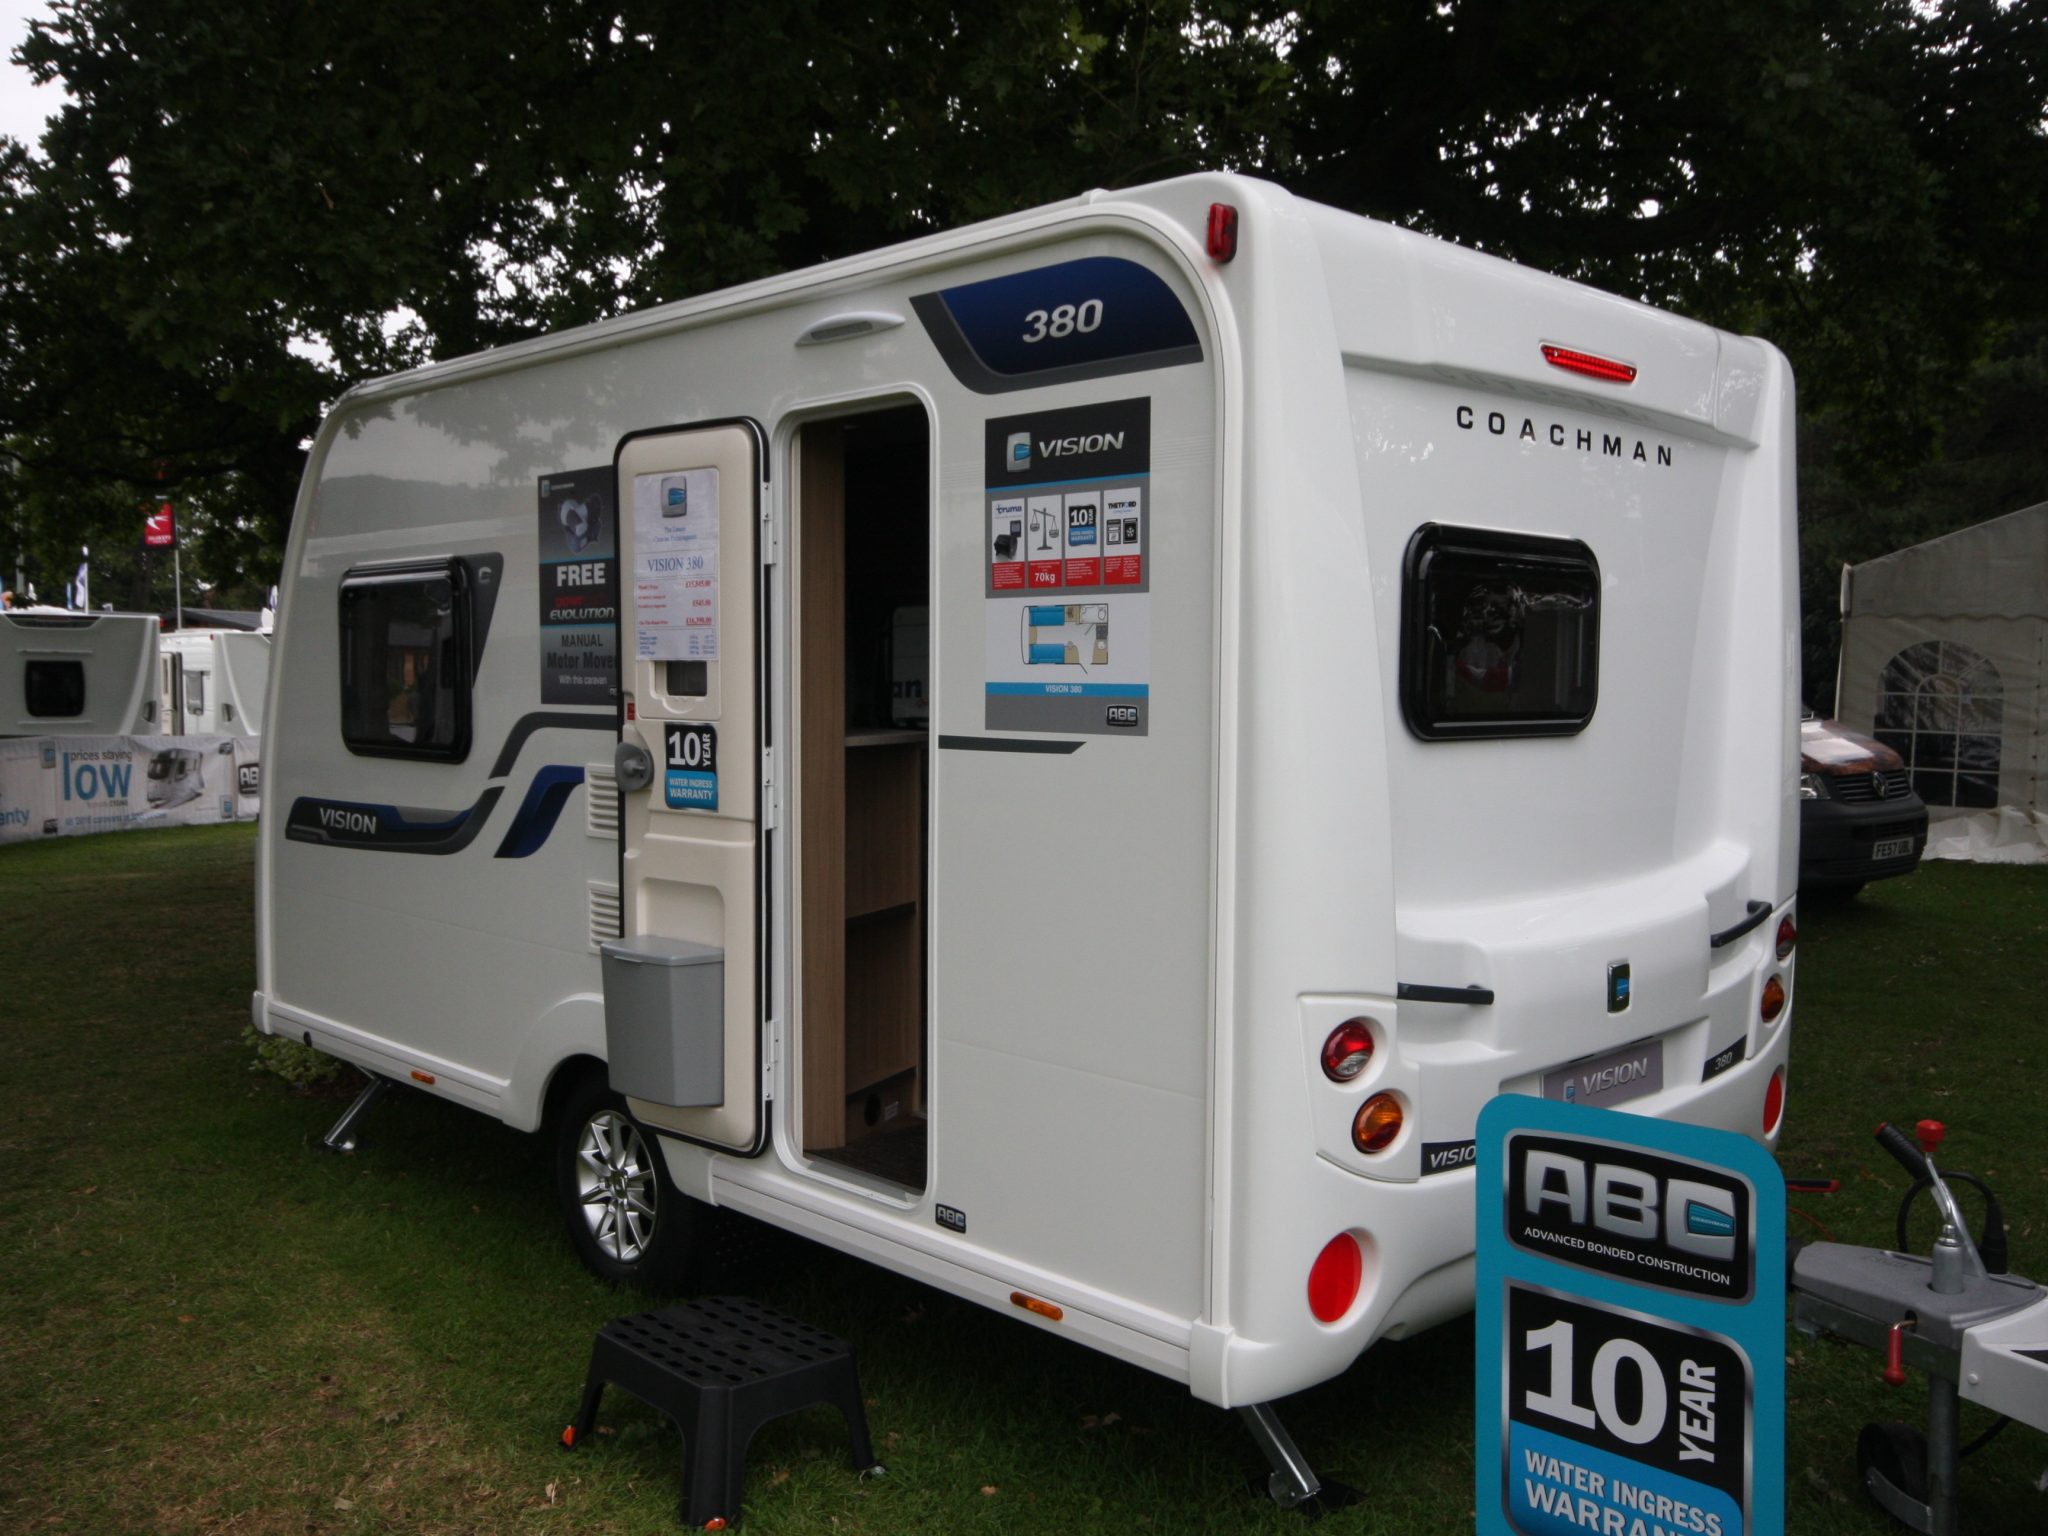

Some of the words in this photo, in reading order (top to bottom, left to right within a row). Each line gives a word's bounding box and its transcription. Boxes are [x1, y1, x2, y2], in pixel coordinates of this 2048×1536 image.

[1022, 298, 1104, 343] 380
[1039, 431, 1125, 459] VISION
[1455, 405, 1672, 467] COACHMAN
[996, 503, 1022, 514] truma
[1107, 500, 1137, 510] THETFORD
[1070, 508, 1088, 526] 10
[648, 557, 684, 572] VISION
[686, 555, 704, 570] 380
[556, 562, 606, 588] FREE
[1034, 571, 1056, 584] 70kg
[550, 606, 615, 621] EVOLUTION
[561, 633, 604, 648] MANUAL
[547, 652, 580, 669] Motor
[572, 675, 583, 685] this
[1045, 684, 1069, 693] VISION
[71, 751, 100, 762] prices
[102, 750, 132, 762] staying
[668, 731, 701, 767] 10
[702, 733, 711, 768] YEAR
[63, 752, 132, 801] low
[669, 777, 688, 787] WATER
[689, 778, 713, 789] INGRESS
[670, 788, 713, 800] WARRANTY
[319, 807, 377, 834] VISION
[1714, 1051, 1733, 1071] 380
[1582, 1057, 1648, 1096] VISION
[1430, 1145, 1476, 1169] VISIO
[1524, 1149, 1736, 1261] ABC
[937, 1206, 965, 1227] ABC
[1524, 1226, 1586, 1249] ADVANCED
[1587, 1241, 1636, 1262] BONDED
[1637, 1253, 1731, 1286] CONSTRUCTION
[1525, 1319, 1668, 1445] 10
[1679, 1358, 1716, 1464] YEAR
[1524, 1449, 1606, 1499] WATER
[1613, 1480, 1724, 1536] INGRESS
